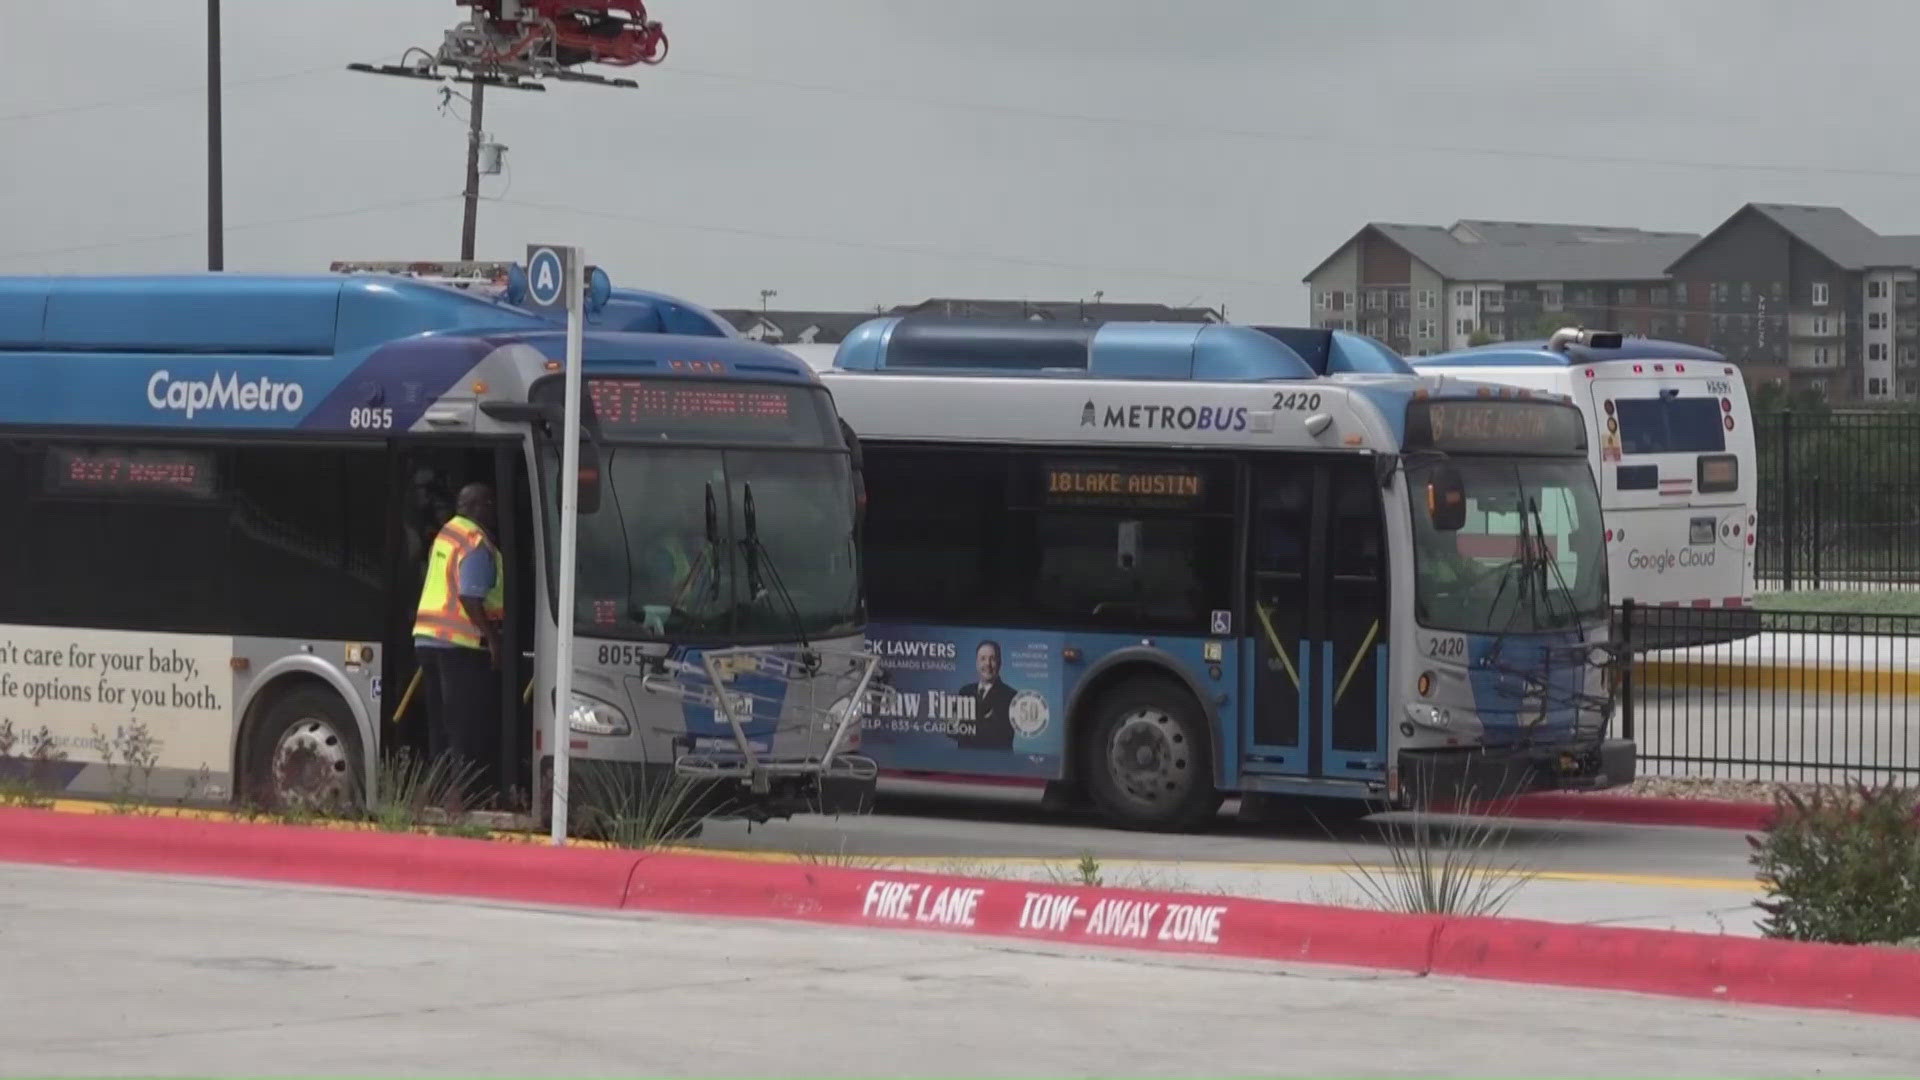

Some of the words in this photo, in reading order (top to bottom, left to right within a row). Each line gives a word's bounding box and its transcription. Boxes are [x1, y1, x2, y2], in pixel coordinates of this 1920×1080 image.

[537, 261, 553, 289] A
[147, 370, 303, 418] CapMetro
[1272, 392, 1321, 410] 2420
[350, 407, 393, 428] 8055
[1103, 405, 1247, 430] METROBUS
[1050, 472, 1072, 491] 18
[1075, 473, 1121, 491] LAKE
[1128, 475, 1198, 494] AUSTIN
[1628, 549, 1675, 573] Google
[1678, 547, 1715, 567] Cloud
[887, 640, 956, 658] LAWYERS
[1430, 638, 1464, 656] 2420
[24, 648, 63, 667] care
[69, 643, 96, 669] for
[101, 652, 144, 676] your
[149, 648, 199, 682] baby,
[23, 677, 92, 707] options
[98, 678, 125, 704] for
[131, 689, 166, 713] you
[172, 683, 222, 711] both.
[928, 689, 977, 720] Firm
[863, 881, 919, 920] FIRE
[915, 885, 984, 926] LANE
[1157, 903, 1228, 944] ZONE
